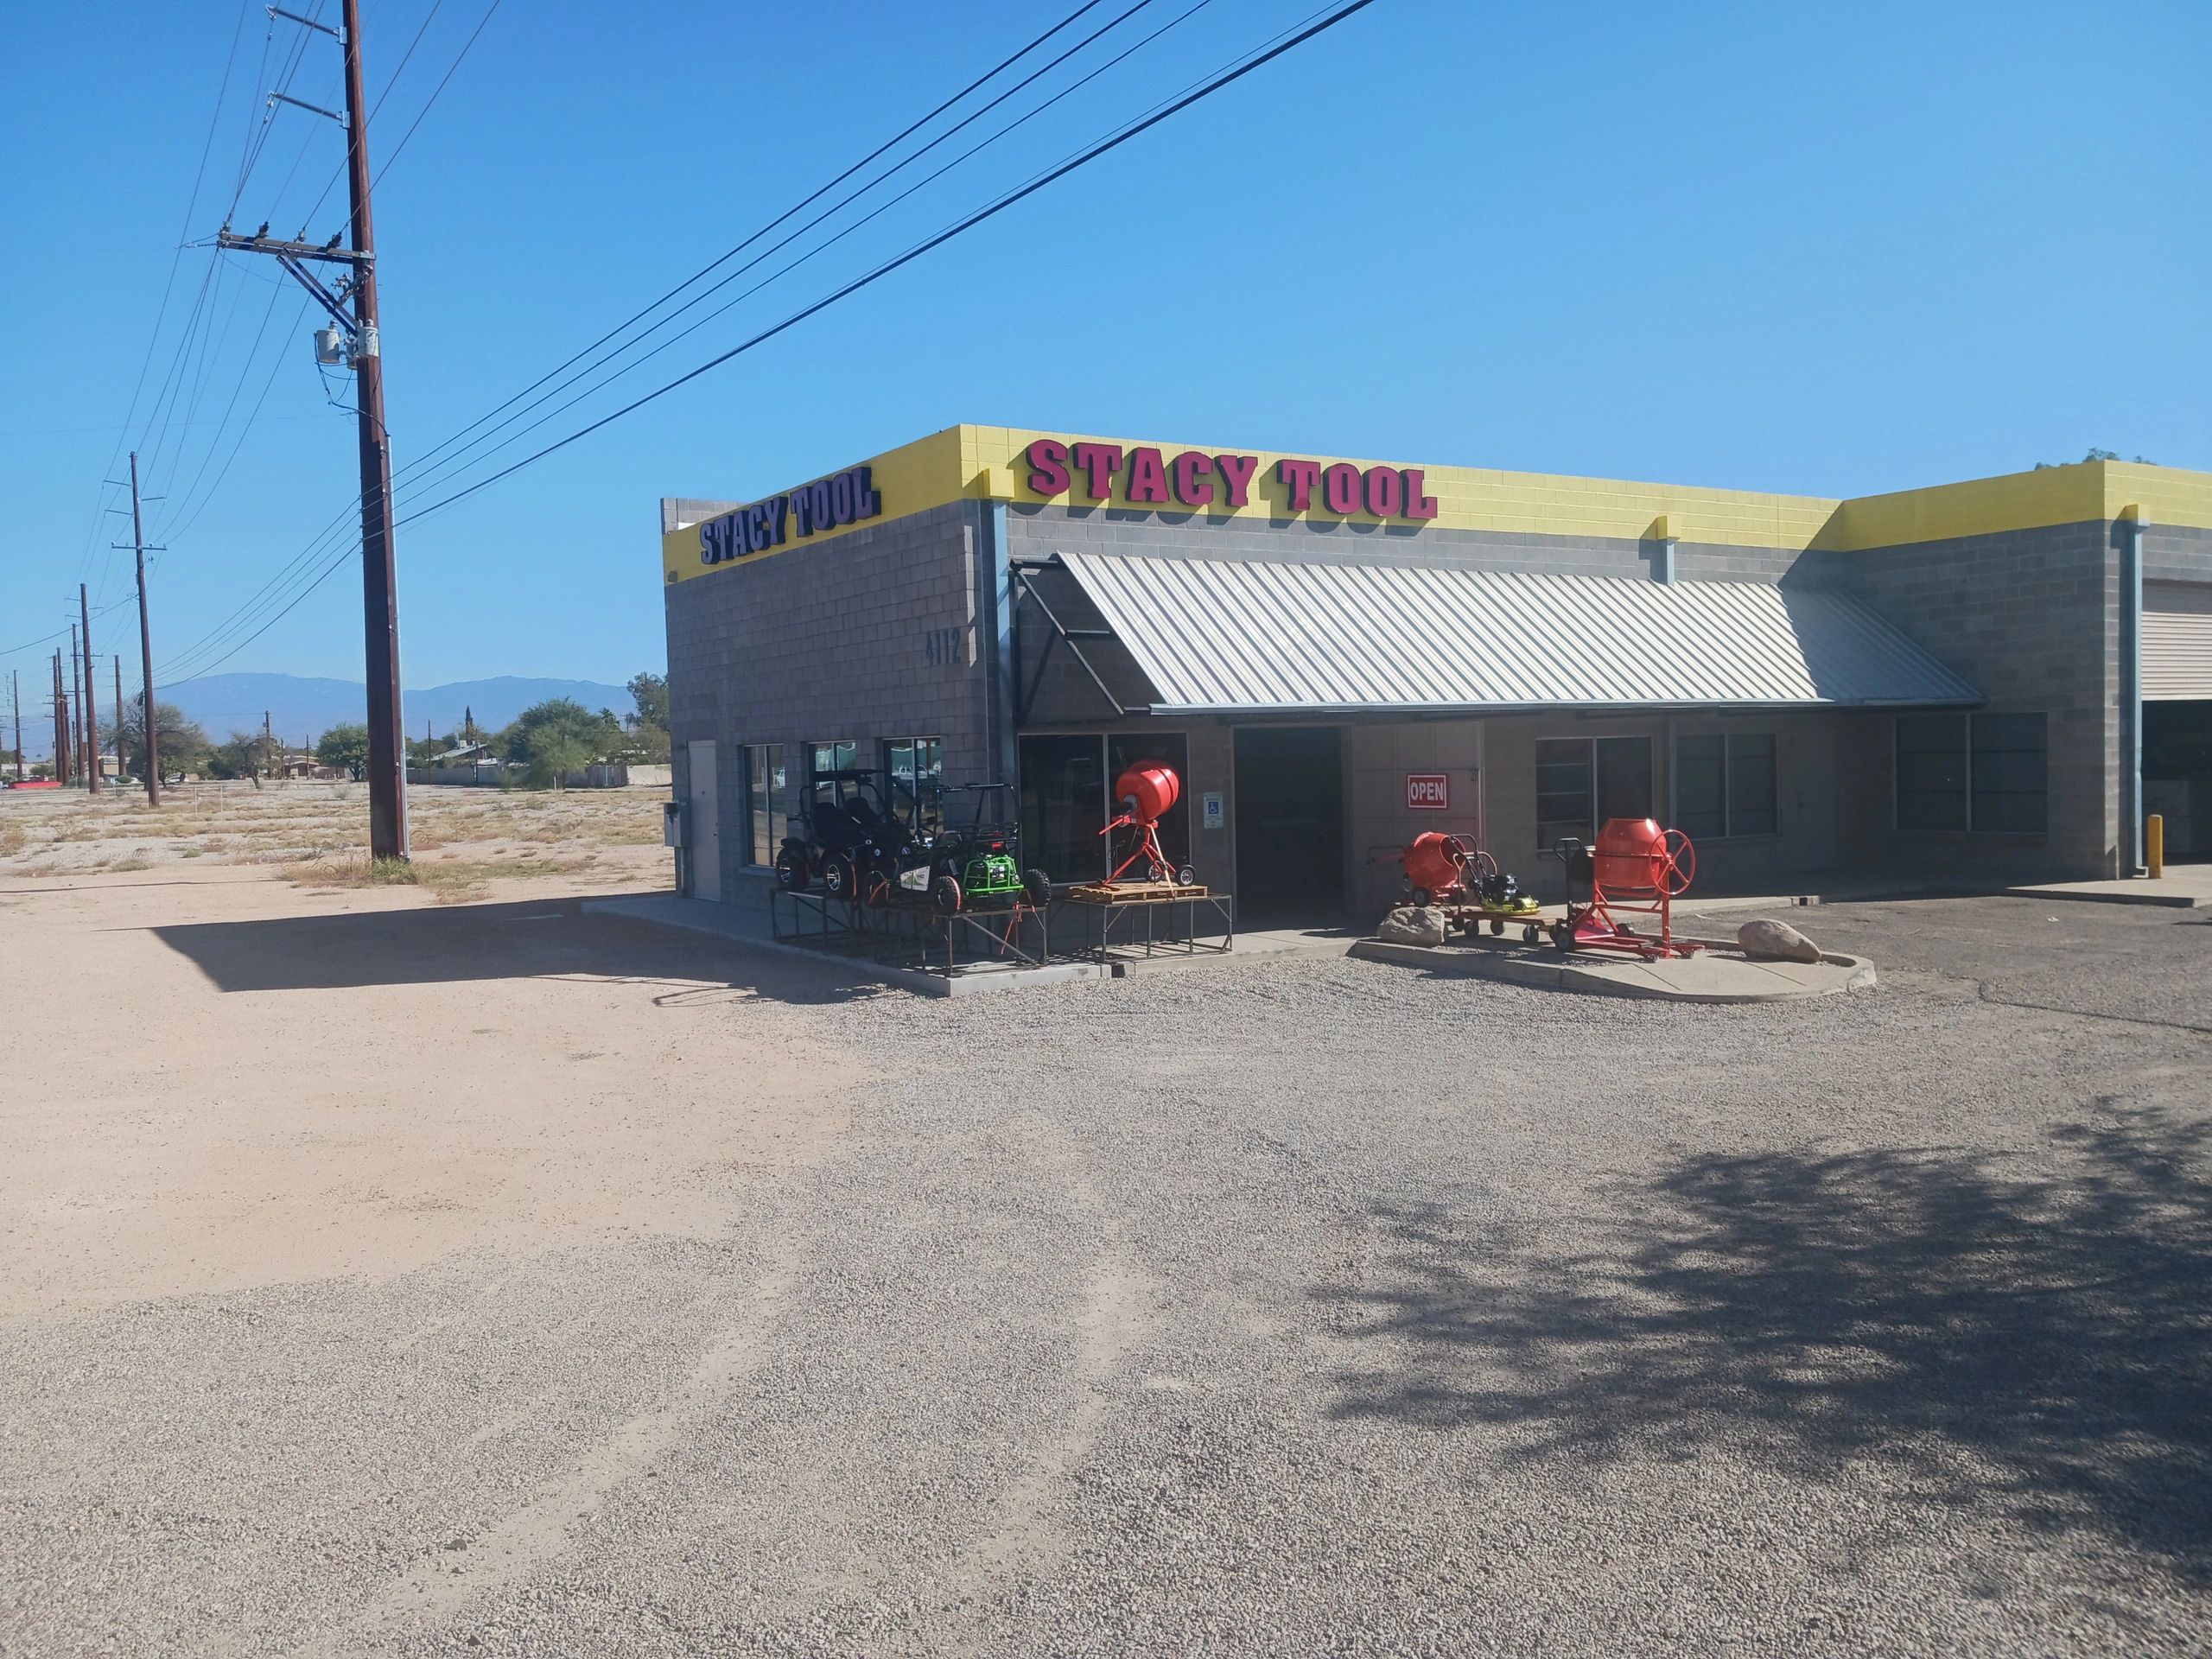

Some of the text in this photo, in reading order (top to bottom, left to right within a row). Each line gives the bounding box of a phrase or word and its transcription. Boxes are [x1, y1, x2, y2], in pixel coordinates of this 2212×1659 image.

[1027, 439, 1438, 519] STACY TOOL
[700, 467, 881, 565] STACY TOOL
[926, 627, 961, 665] 4112
[1410, 782, 1444, 800] OPEN
